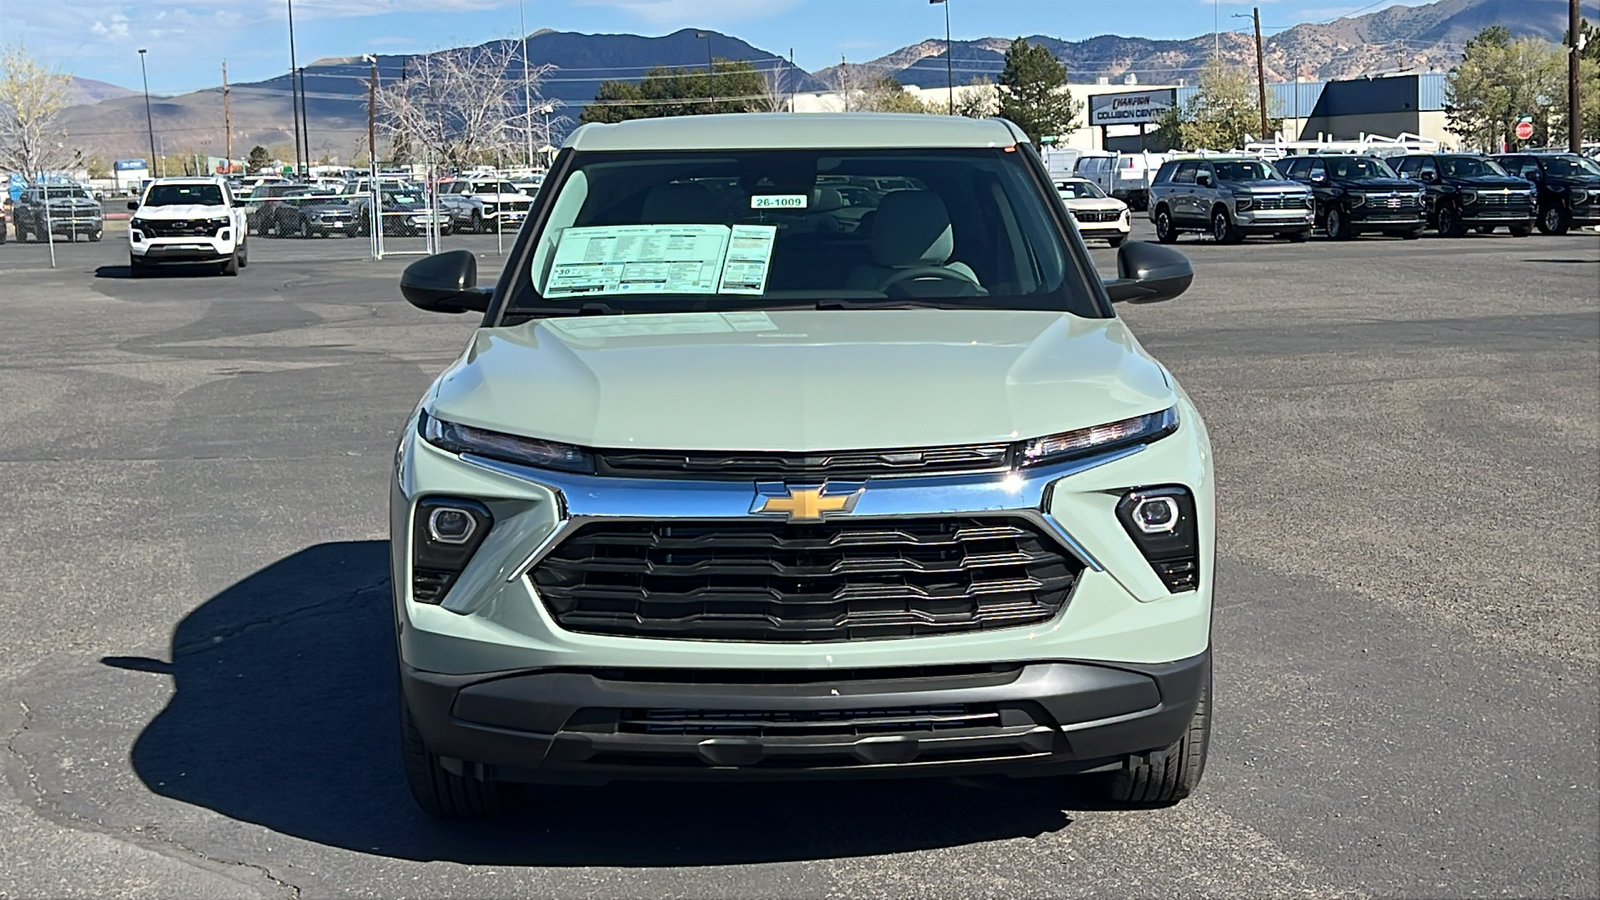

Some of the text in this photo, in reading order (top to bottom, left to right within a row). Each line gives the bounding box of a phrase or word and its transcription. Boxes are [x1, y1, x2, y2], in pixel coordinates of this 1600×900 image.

[1112, 96, 1150, 110] CHAMPION
[1097, 110, 1134, 120] COLLISION
[756, 198, 801, 207] 26-1009
